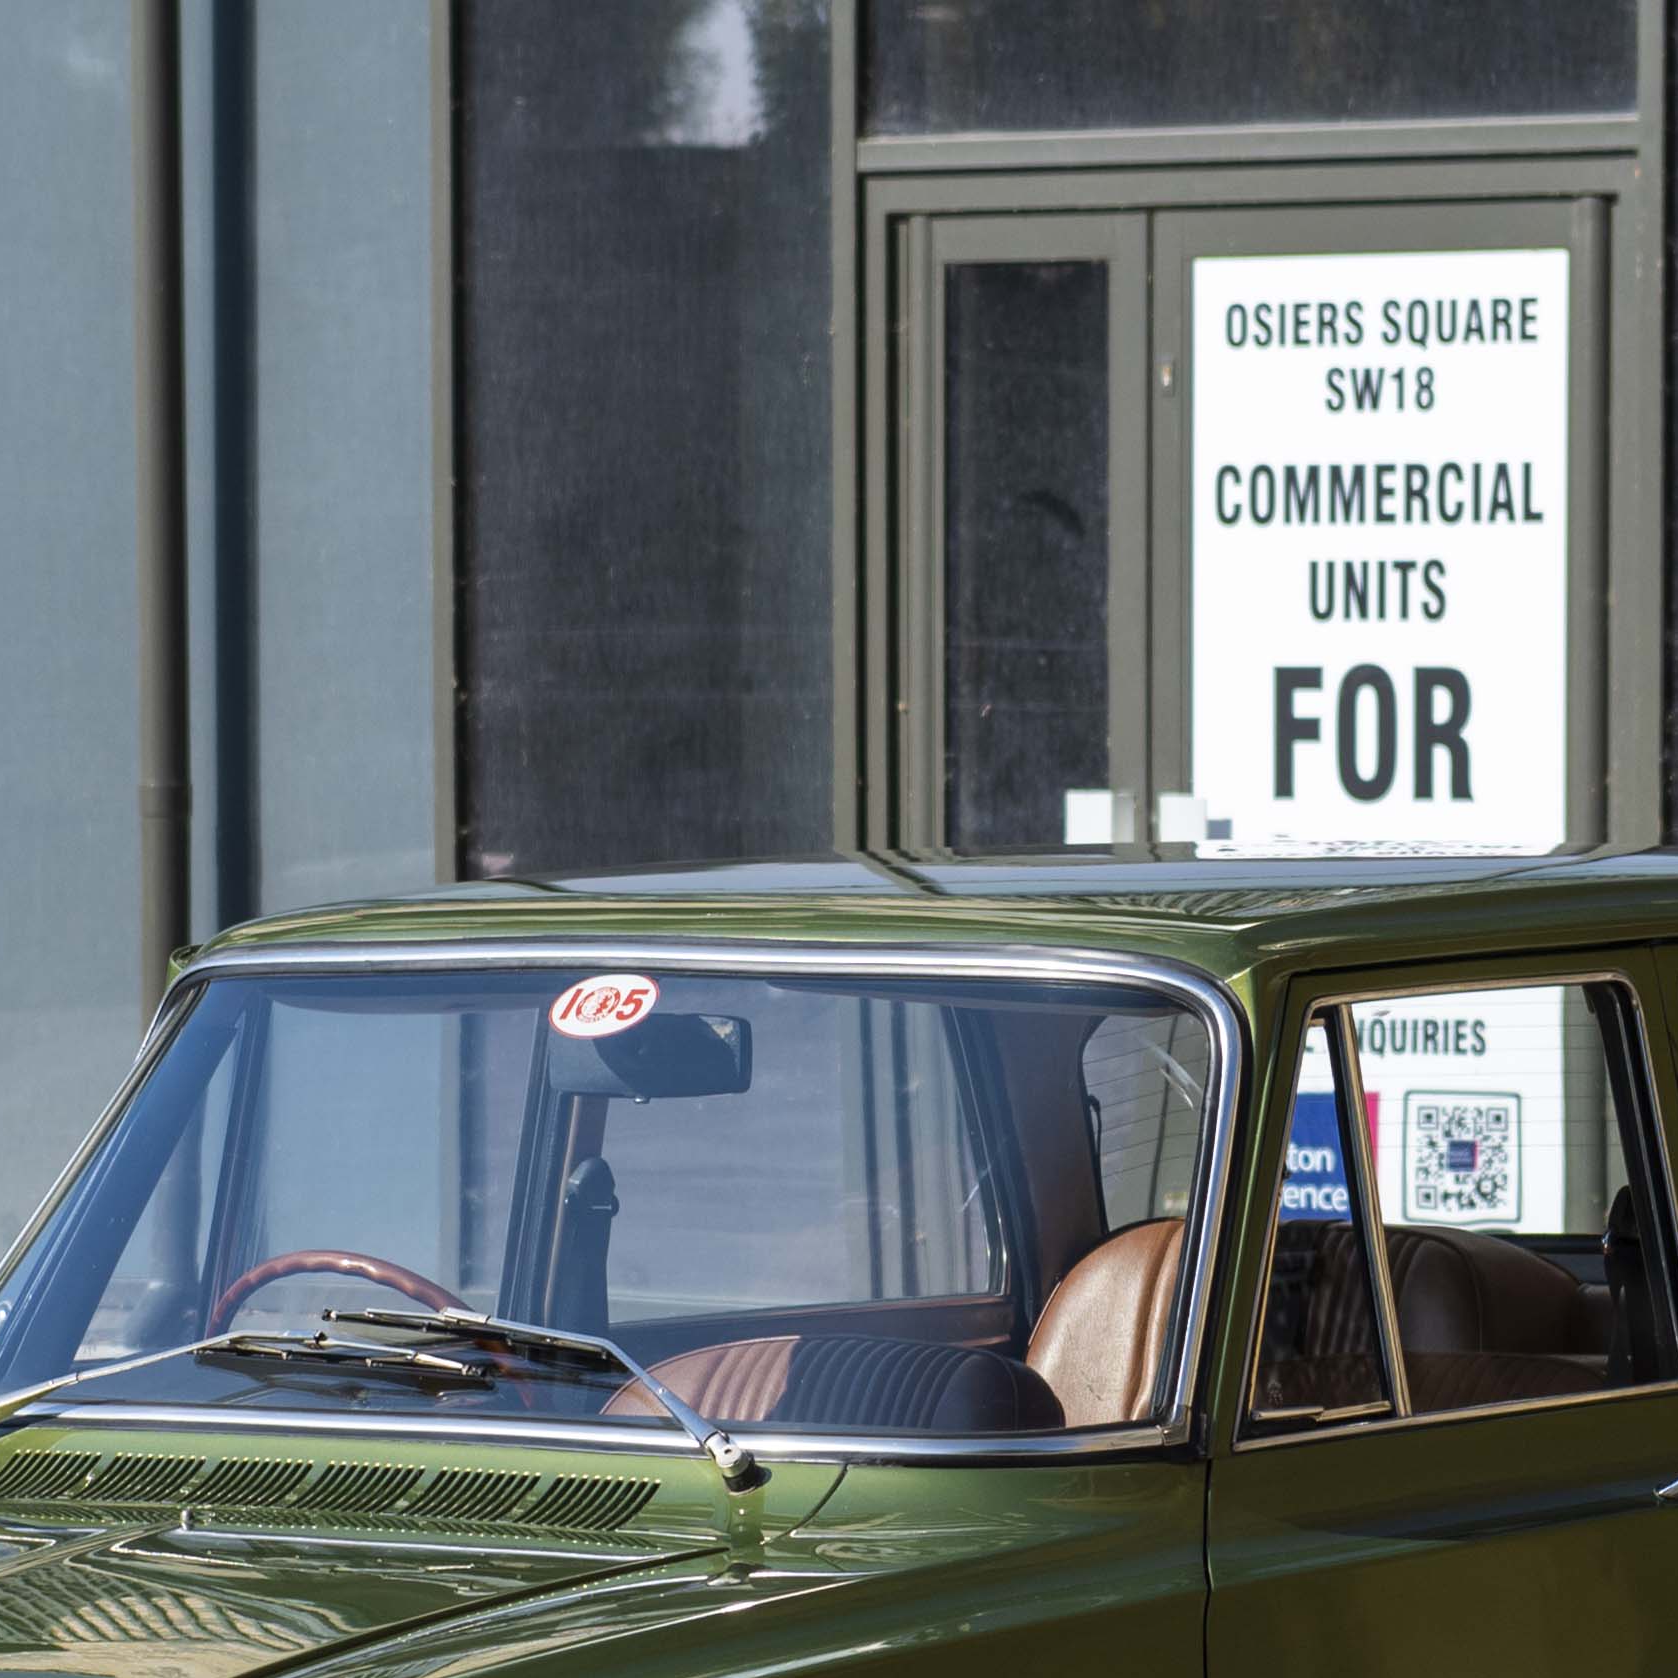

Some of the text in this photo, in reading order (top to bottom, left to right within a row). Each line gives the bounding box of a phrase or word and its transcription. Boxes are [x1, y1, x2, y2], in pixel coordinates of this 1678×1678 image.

[1226, 298, 1538, 349] OSIERS SQUARE
[1326, 367, 1435, 412] SW18
[1216, 462, 1544, 526] COMMERCIAL
[1309, 559, 1447, 622] UNITS
[1273, 663, 1474, 804] FOR
[1280, 1184, 1347, 1211] ence
